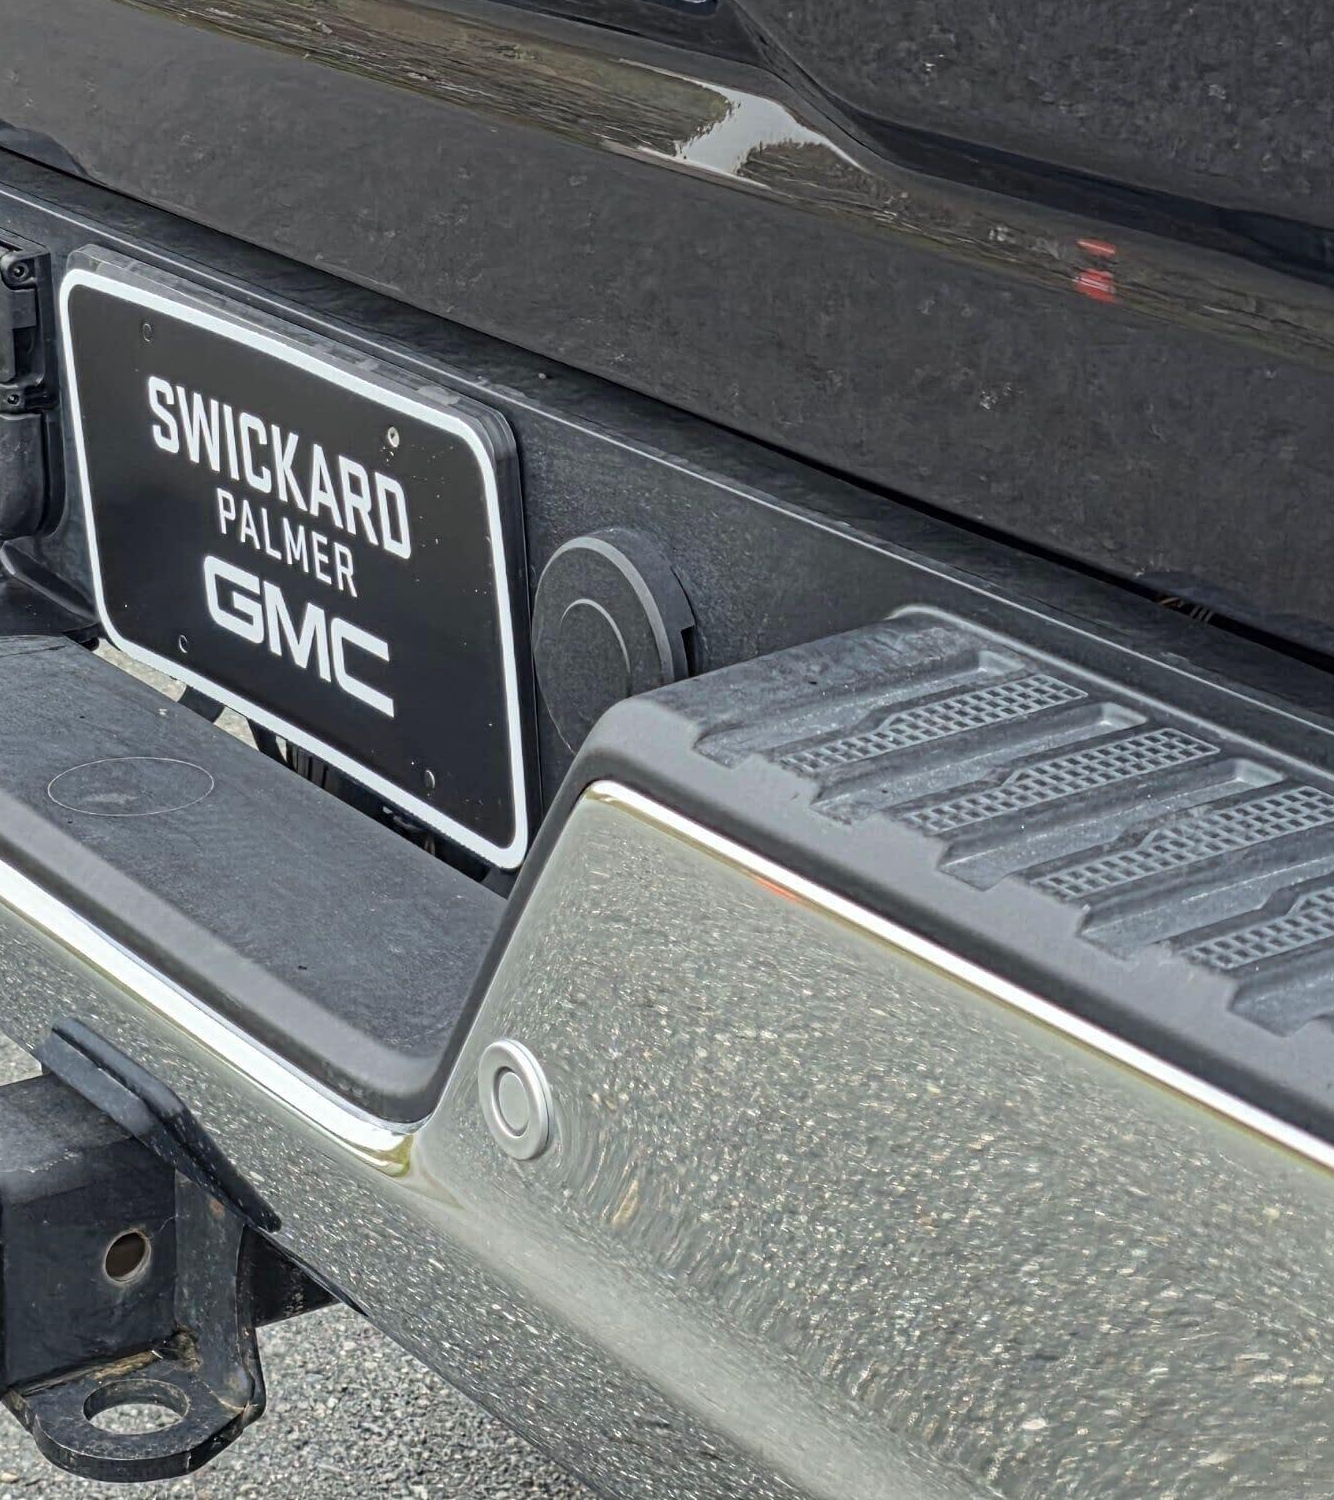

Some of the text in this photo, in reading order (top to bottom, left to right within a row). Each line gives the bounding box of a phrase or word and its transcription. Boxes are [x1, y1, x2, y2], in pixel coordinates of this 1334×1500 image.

[149, 377, 410, 558] SWICKARD
[217, 490, 357, 596] PALMER
[204, 556, 395, 716] GMC
